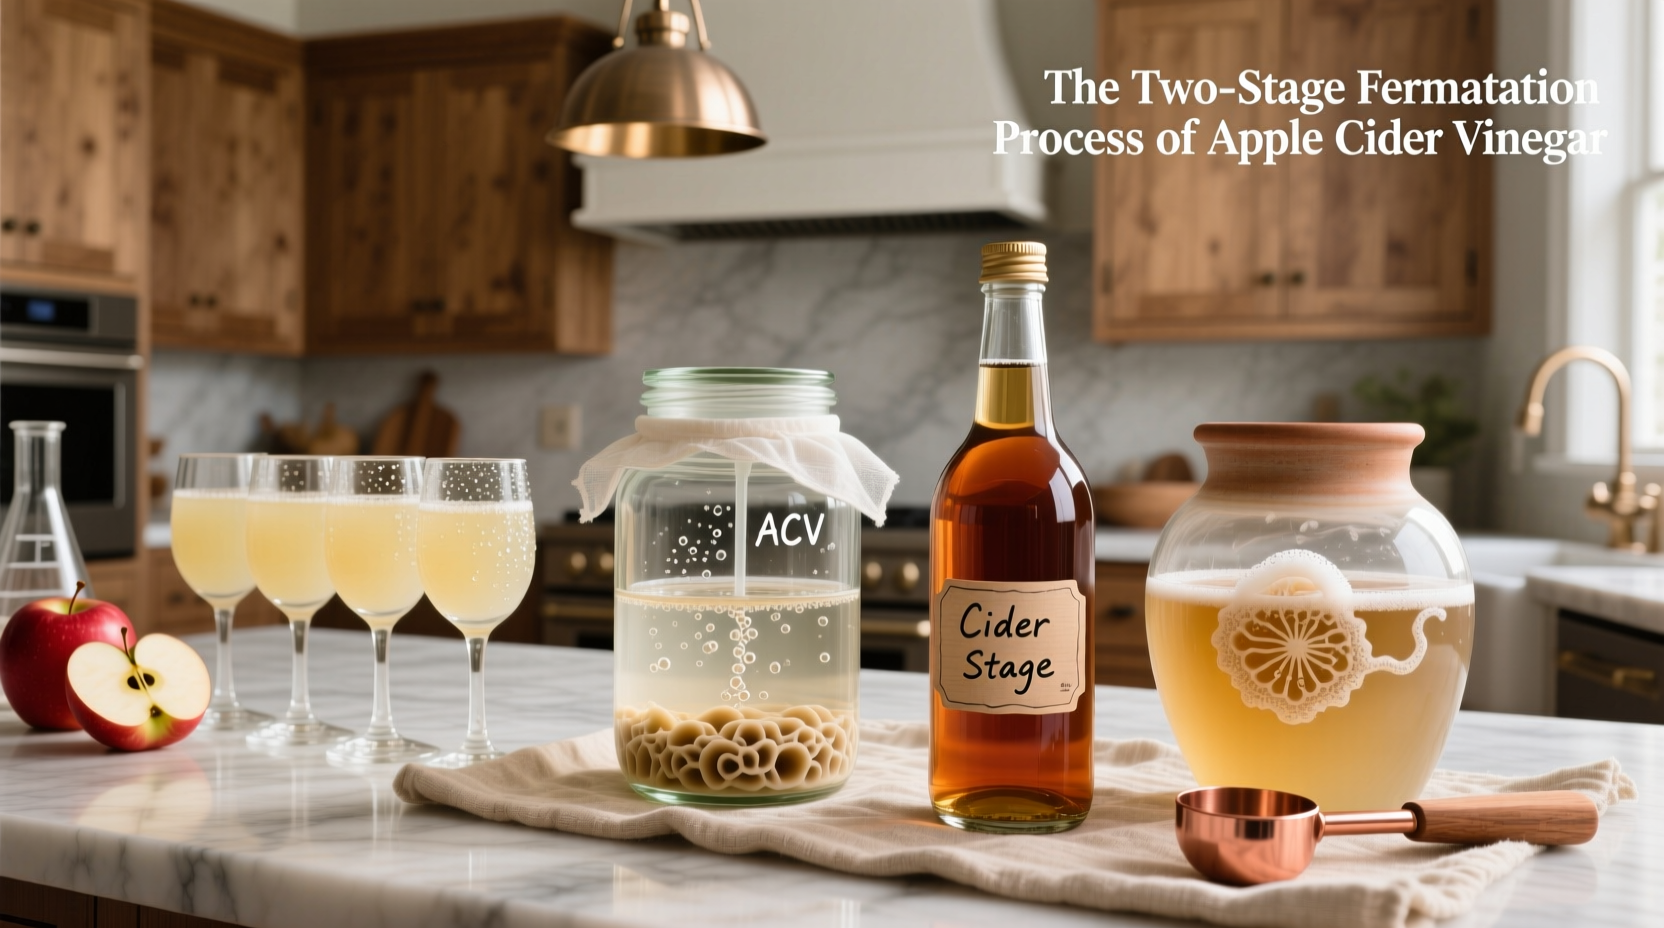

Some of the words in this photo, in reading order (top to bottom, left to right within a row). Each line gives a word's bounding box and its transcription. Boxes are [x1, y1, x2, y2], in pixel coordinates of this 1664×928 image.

[755, 511, 825, 548] ACV
[960, 602, 1051, 639] Cider
[963, 649, 1055, 695] Stage
